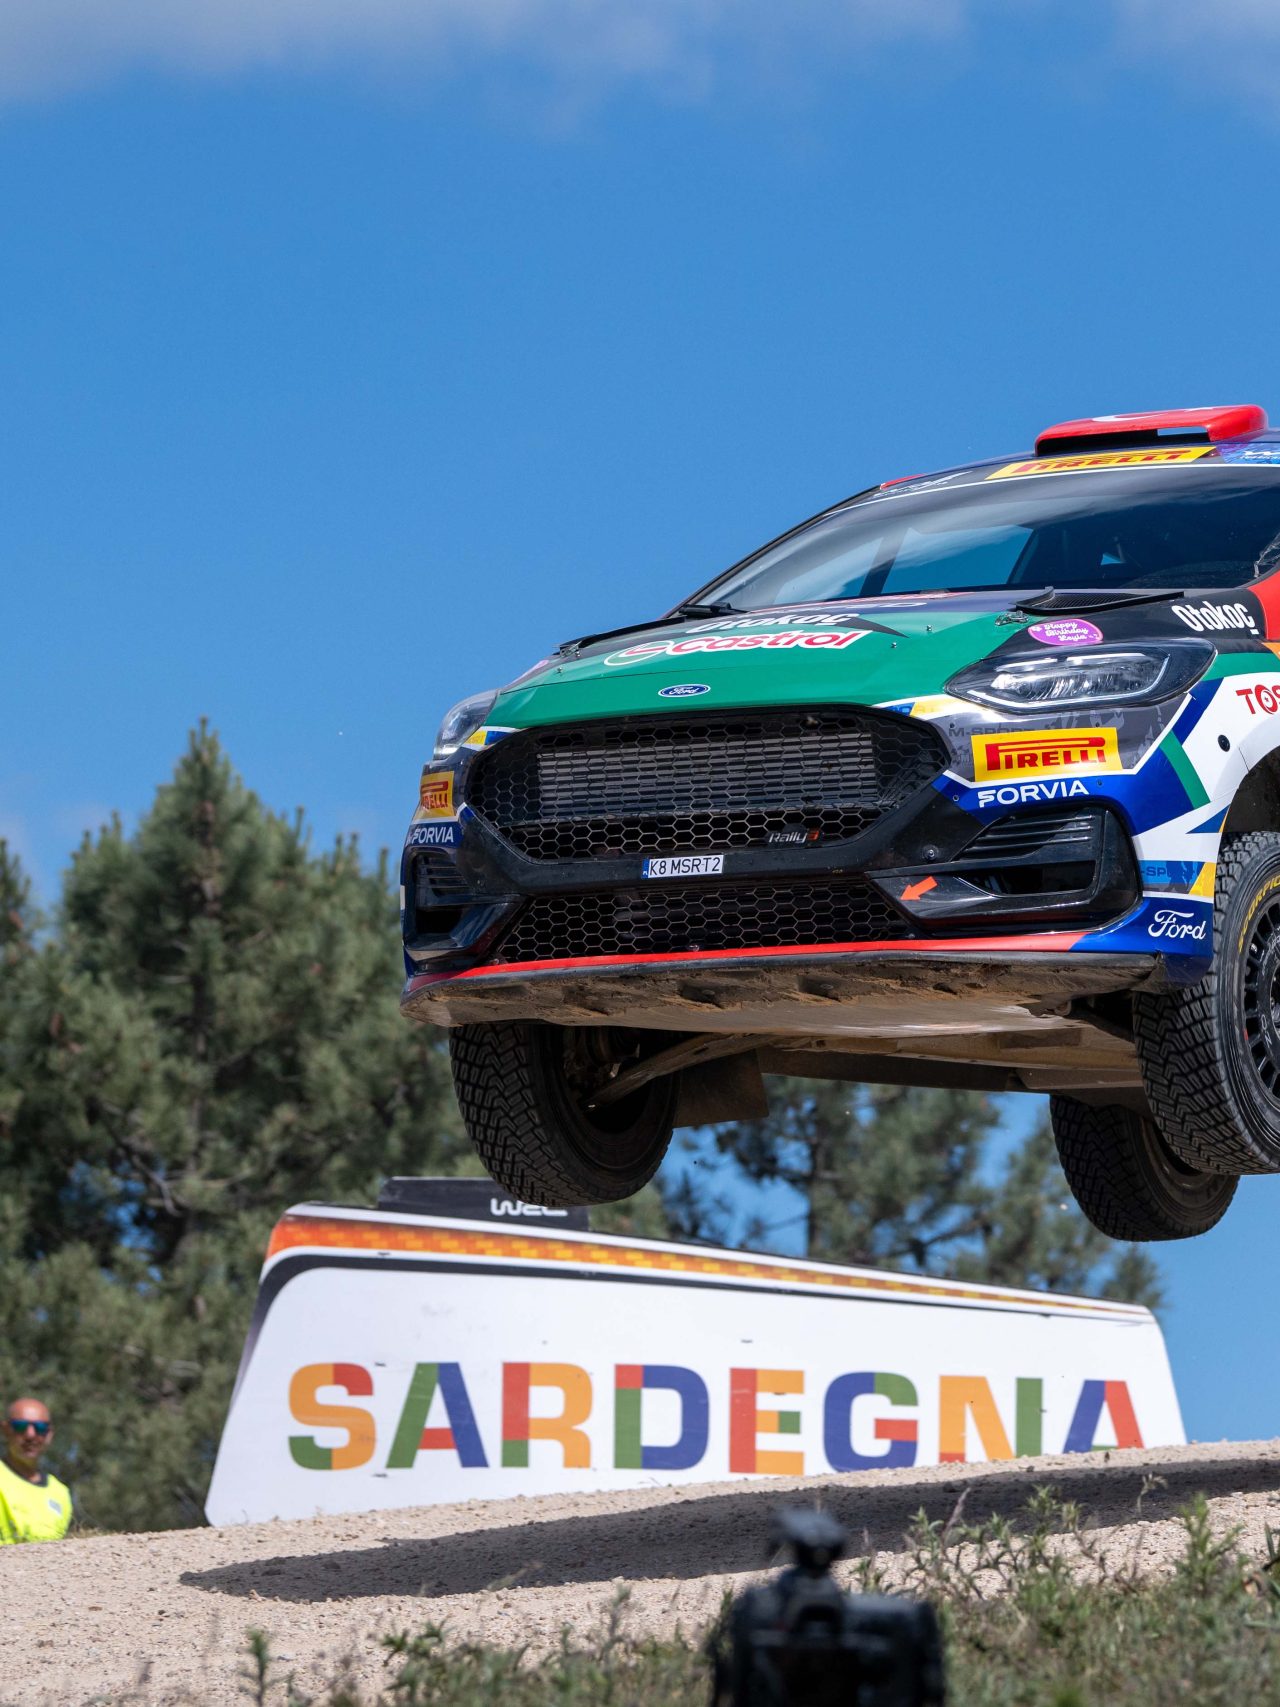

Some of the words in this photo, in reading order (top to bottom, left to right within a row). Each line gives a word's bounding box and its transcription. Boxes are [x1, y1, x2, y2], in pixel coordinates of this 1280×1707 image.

[1012, 450, 1191, 473] PIRELLI
[665, 629, 873, 655] Castrol
[985, 737, 1106, 770] PIRELLI
[978, 780, 1090, 808] FORVIA
[412, 826, 455, 844] FORVIA
[768, 827, 820, 844] Rally3
[650, 859, 667, 876] K8
[1147, 909, 1207, 940] Ford
[287, 1361, 1146, 1476] SARDEGNA
